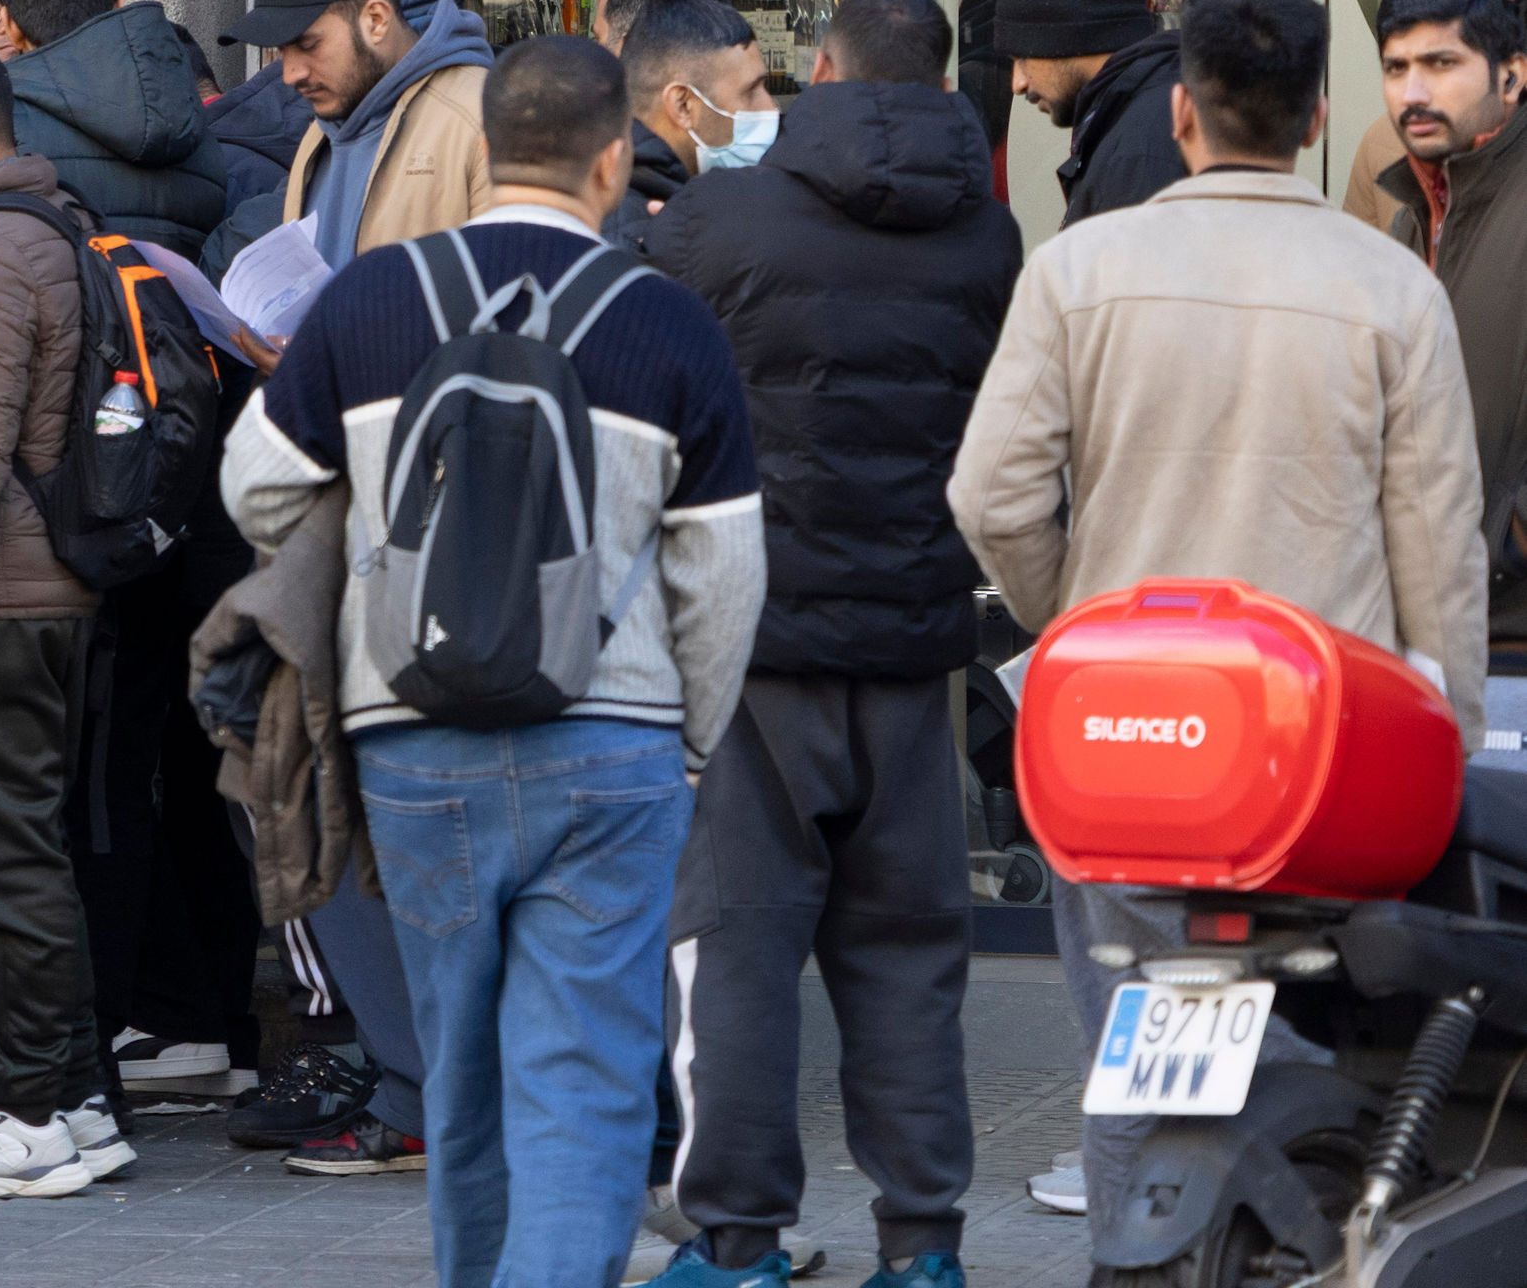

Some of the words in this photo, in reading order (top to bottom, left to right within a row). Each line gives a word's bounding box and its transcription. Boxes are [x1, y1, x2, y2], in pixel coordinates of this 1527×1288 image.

[1083, 715, 1179, 743] SILENCE
[1144, 997, 1256, 1045] 9710
[1110, 1034, 1128, 1057] E
[1125, 1050, 1216, 1101] MWW
